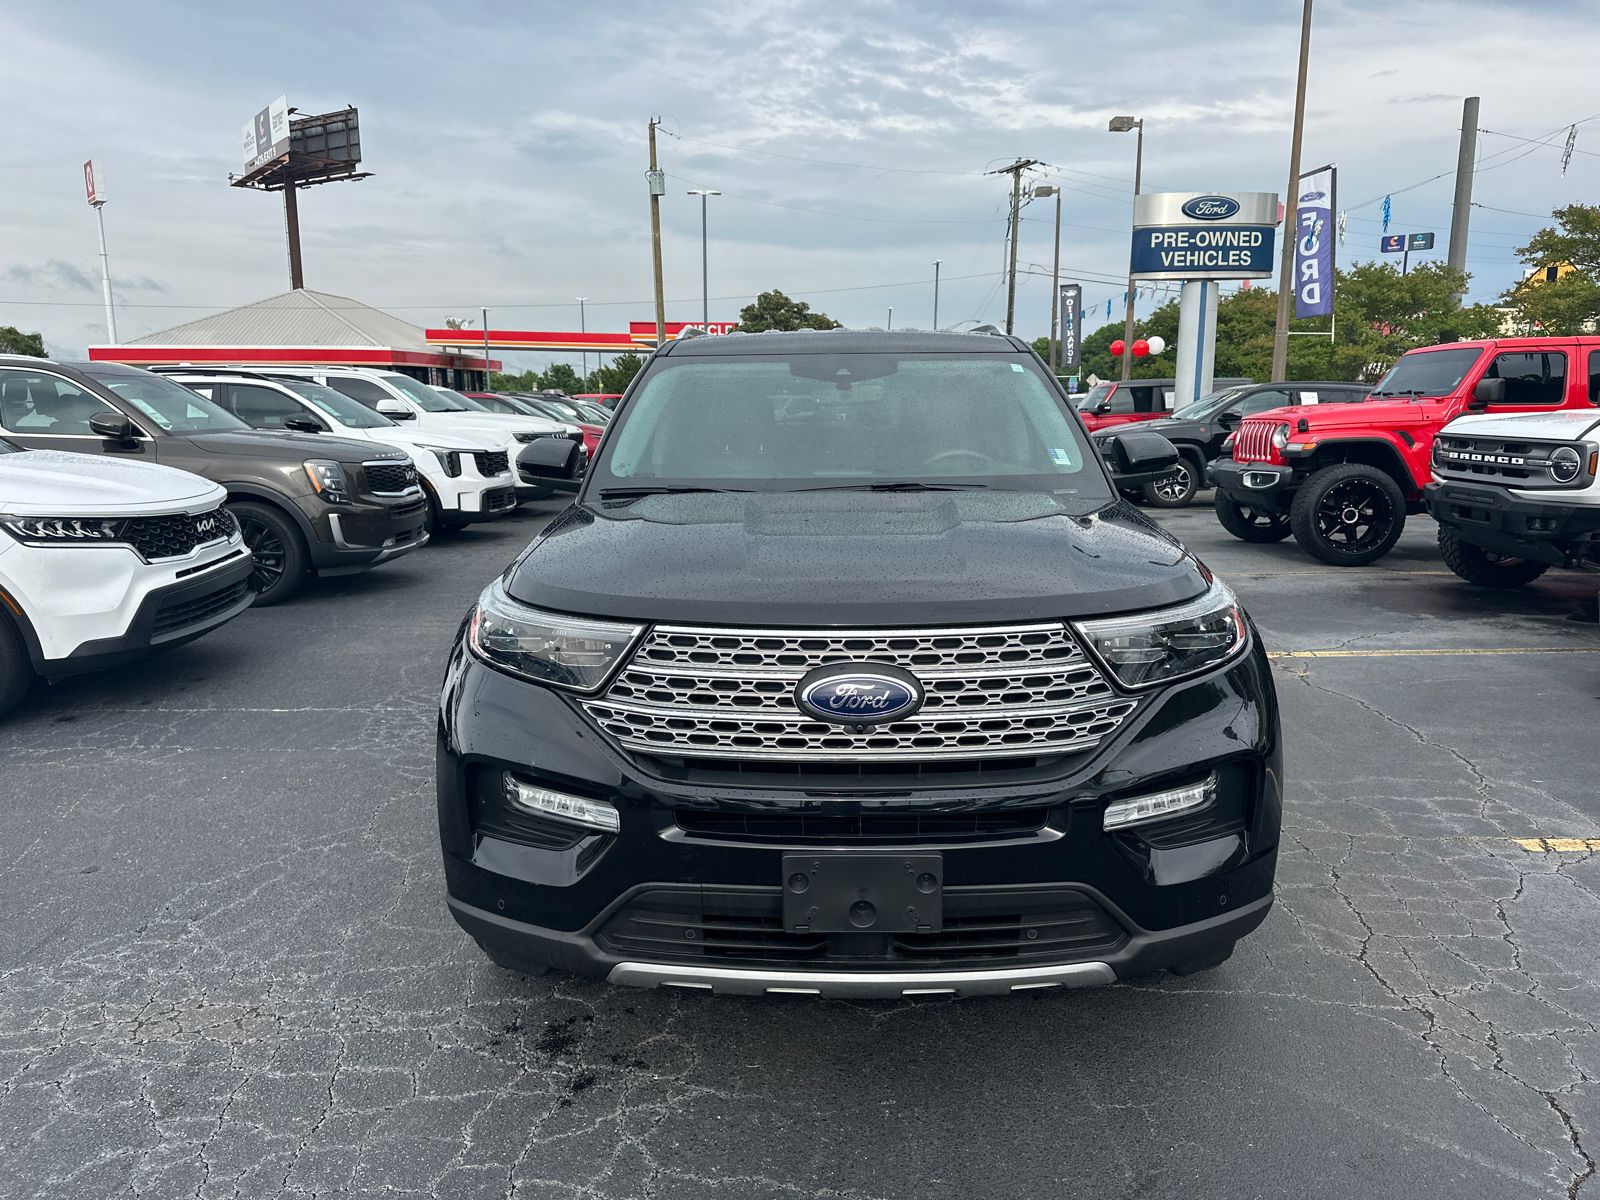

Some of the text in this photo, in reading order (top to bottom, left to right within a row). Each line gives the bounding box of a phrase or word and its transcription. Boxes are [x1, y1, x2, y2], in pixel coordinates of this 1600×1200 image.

[1195, 201, 1229, 215] Ford
[1150, 231, 1263, 248] PRE-OWNED
[1160, 250, 1252, 267] VEHICLES
[683, 324, 732, 336] CLE
[1448, 451, 1524, 465] BRONCO
[829, 683, 891, 709] Ford
